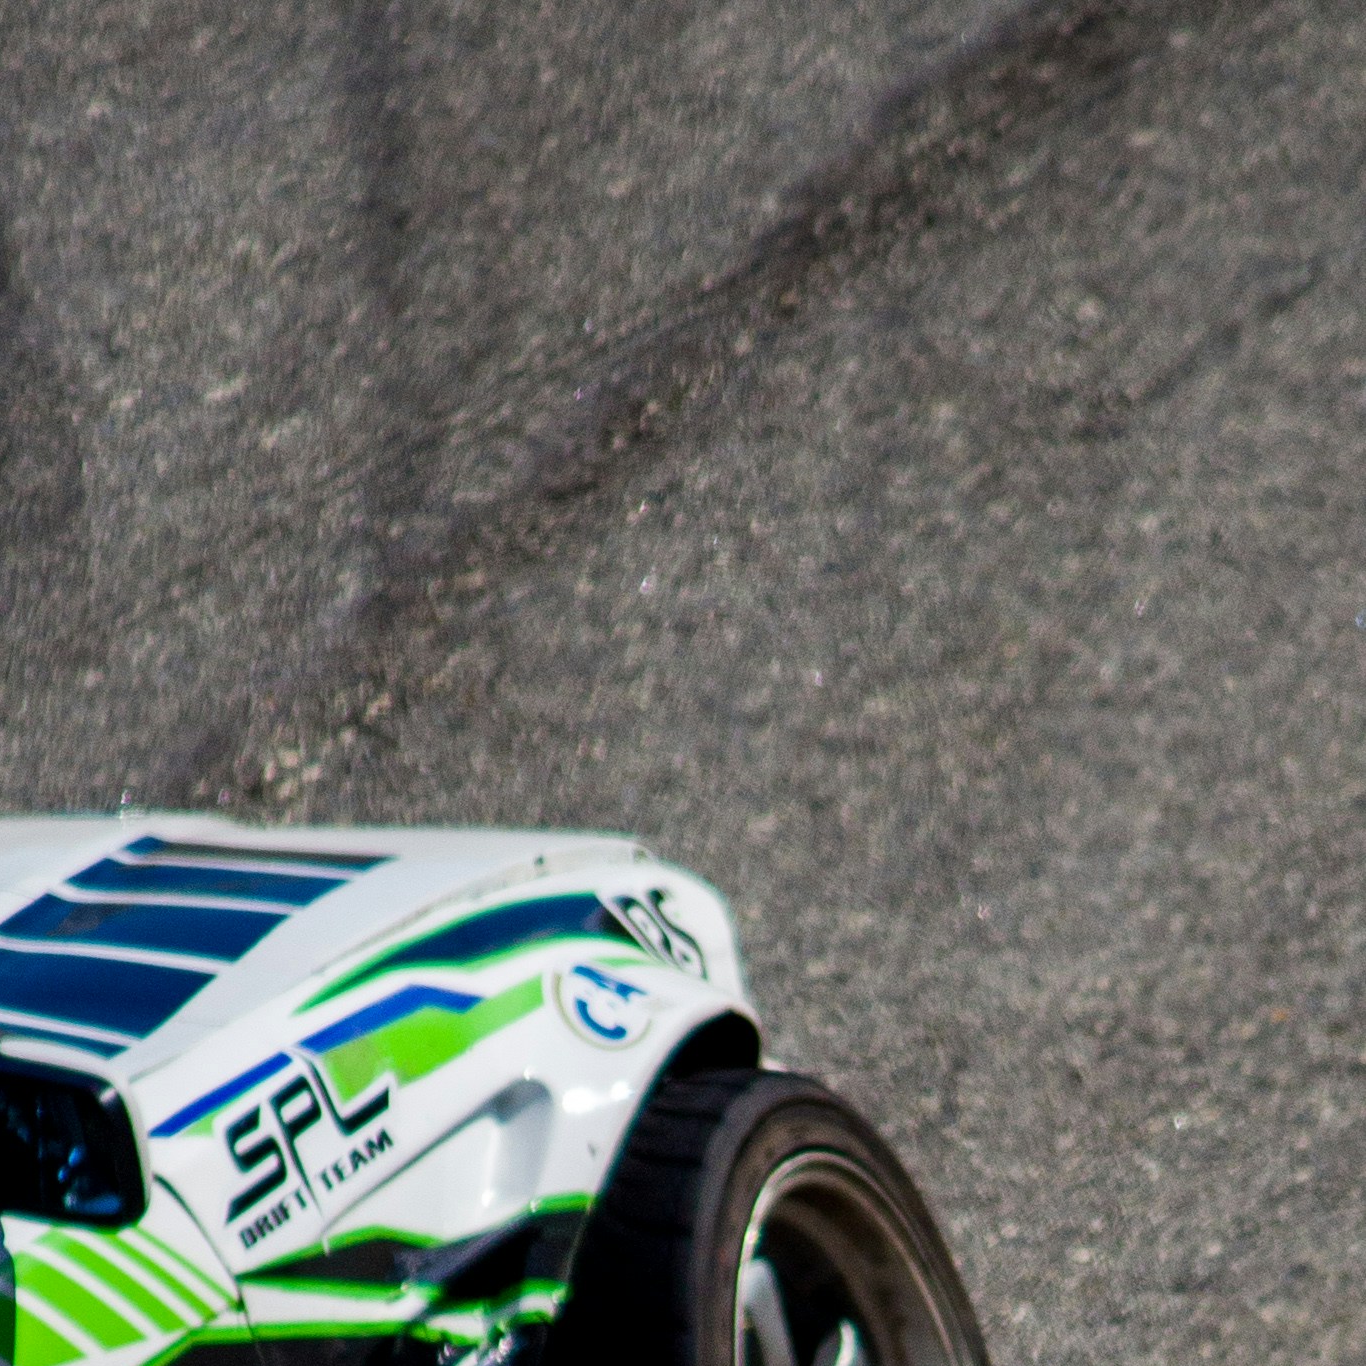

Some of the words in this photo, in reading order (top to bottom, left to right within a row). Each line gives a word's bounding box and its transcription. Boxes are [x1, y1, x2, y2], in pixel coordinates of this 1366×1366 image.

[224, 1058, 391, 1226] SPL
[238, 1188, 308, 1250] DRIFT
[318, 1127, 395, 1193] TEAM
